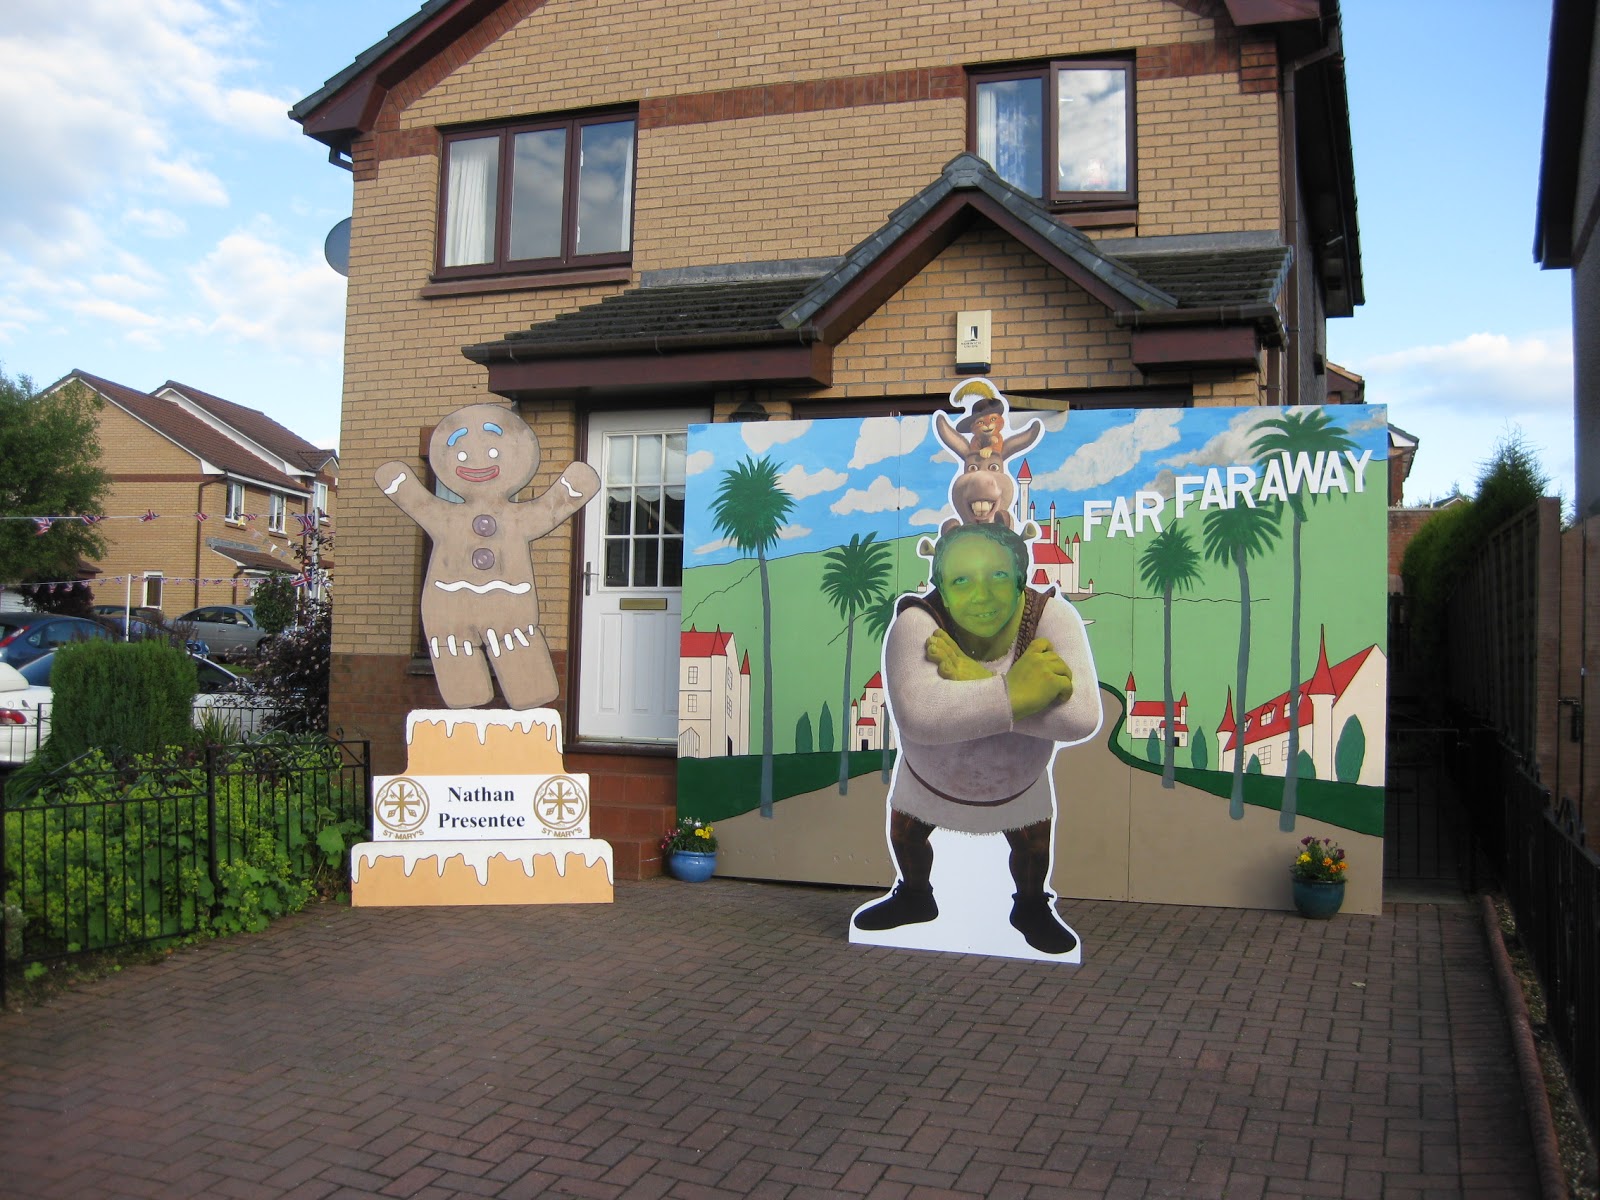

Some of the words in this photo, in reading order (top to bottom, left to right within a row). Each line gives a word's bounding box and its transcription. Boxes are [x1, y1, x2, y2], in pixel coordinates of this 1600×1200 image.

[1083, 490, 1165, 542] FAR
[448, 786, 515, 802] Nathan
[438, 813, 526, 828] Presentee
[383, 829, 394, 838] ST
[395, 829, 425, 840] MARY'S
[541, 827, 553, 836] ST
[553, 827, 583, 838] MARY'S
